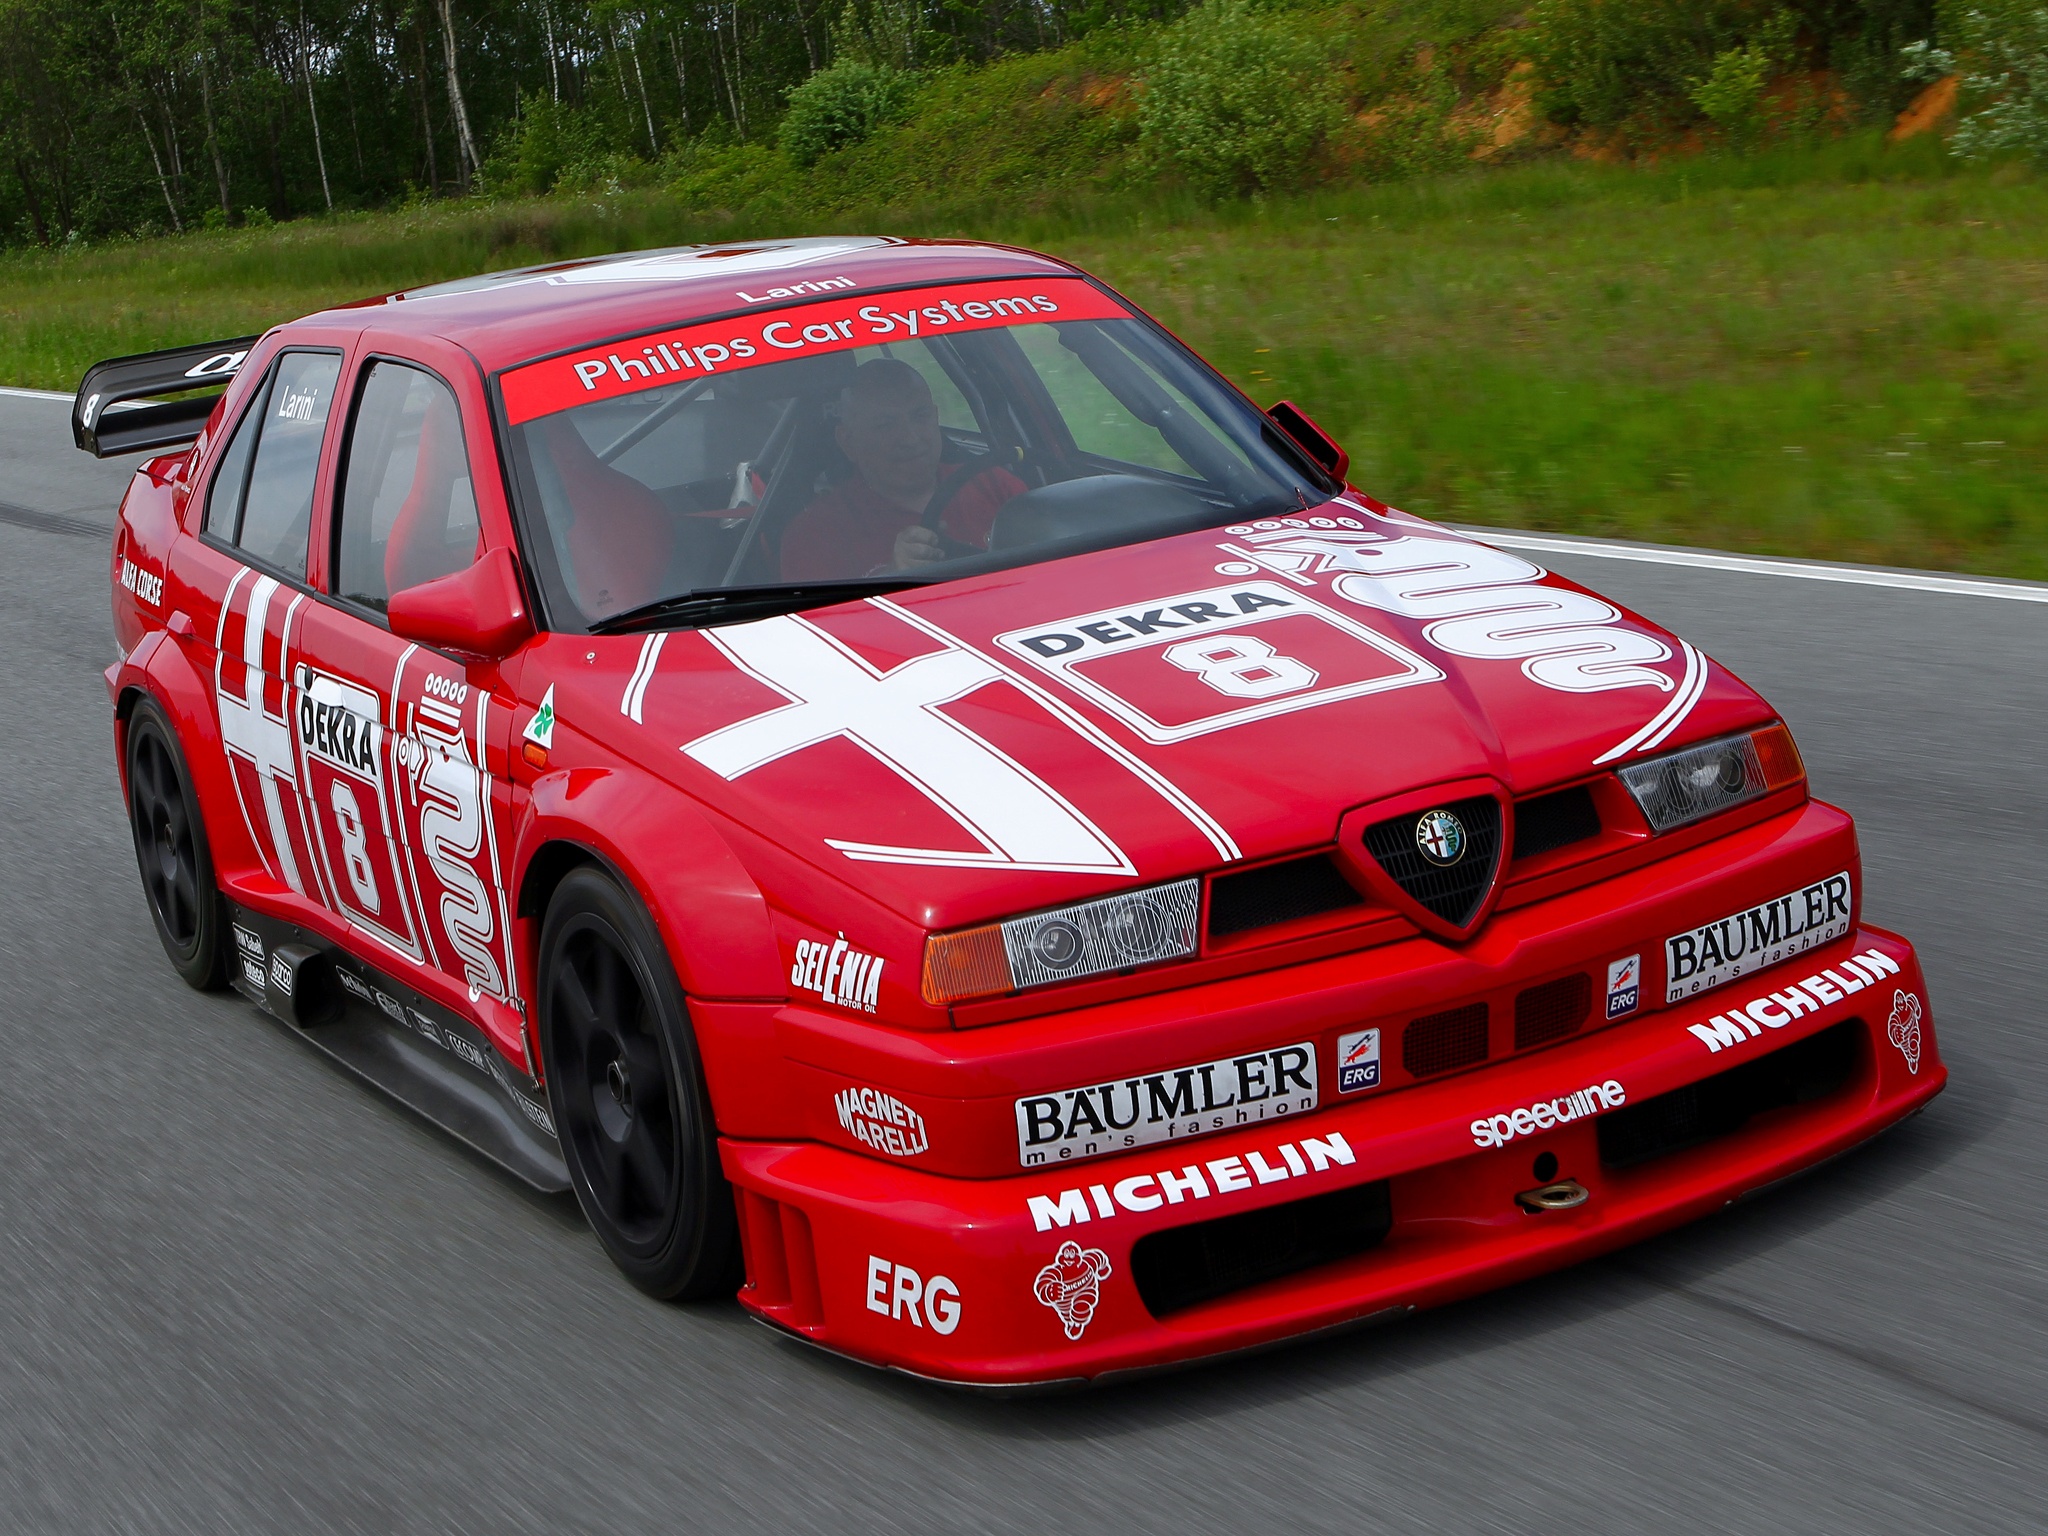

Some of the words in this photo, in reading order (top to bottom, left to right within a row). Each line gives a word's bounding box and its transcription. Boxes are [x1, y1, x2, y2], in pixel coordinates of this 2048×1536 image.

[735, 275, 857, 303] Larini
[573, 338, 757, 391] Philips
[761, 319, 853, 349] Car
[857, 290, 1058, 336] Systems
[82, 393, 100, 428] 8
[278, 385, 318, 421] Larini
[121, 558, 138, 593] ALFA
[136, 568, 163, 607] CORSE
[1018, 592, 1296, 659] DEKRA
[1161, 634, 1321, 699] 8
[301, 694, 377, 777] DEKRA
[331, 777, 381, 917] 8
[1419, 818, 1432, 845] ALFA
[1669, 876, 1848, 983] BÄUMLER
[1669, 963, 1741, 1001] men's
[1760, 921, 1847, 966] fashion
[837, 997, 862, 1011] MOTOR
[864, 1003, 877, 1014] OIL
[1610, 990, 1636, 1012] ERG
[1687, 948, 1901, 1053] MICHELIN
[1021, 1046, 1313, 1147] BÄUMLER
[1342, 1064, 1376, 1086] ERG
[1025, 1133, 1136, 1165] men's
[1167, 1096, 1312, 1138] fashion
[1026, 1131, 1357, 1232] MICHELIN
[866, 1254, 962, 1336] ERG
